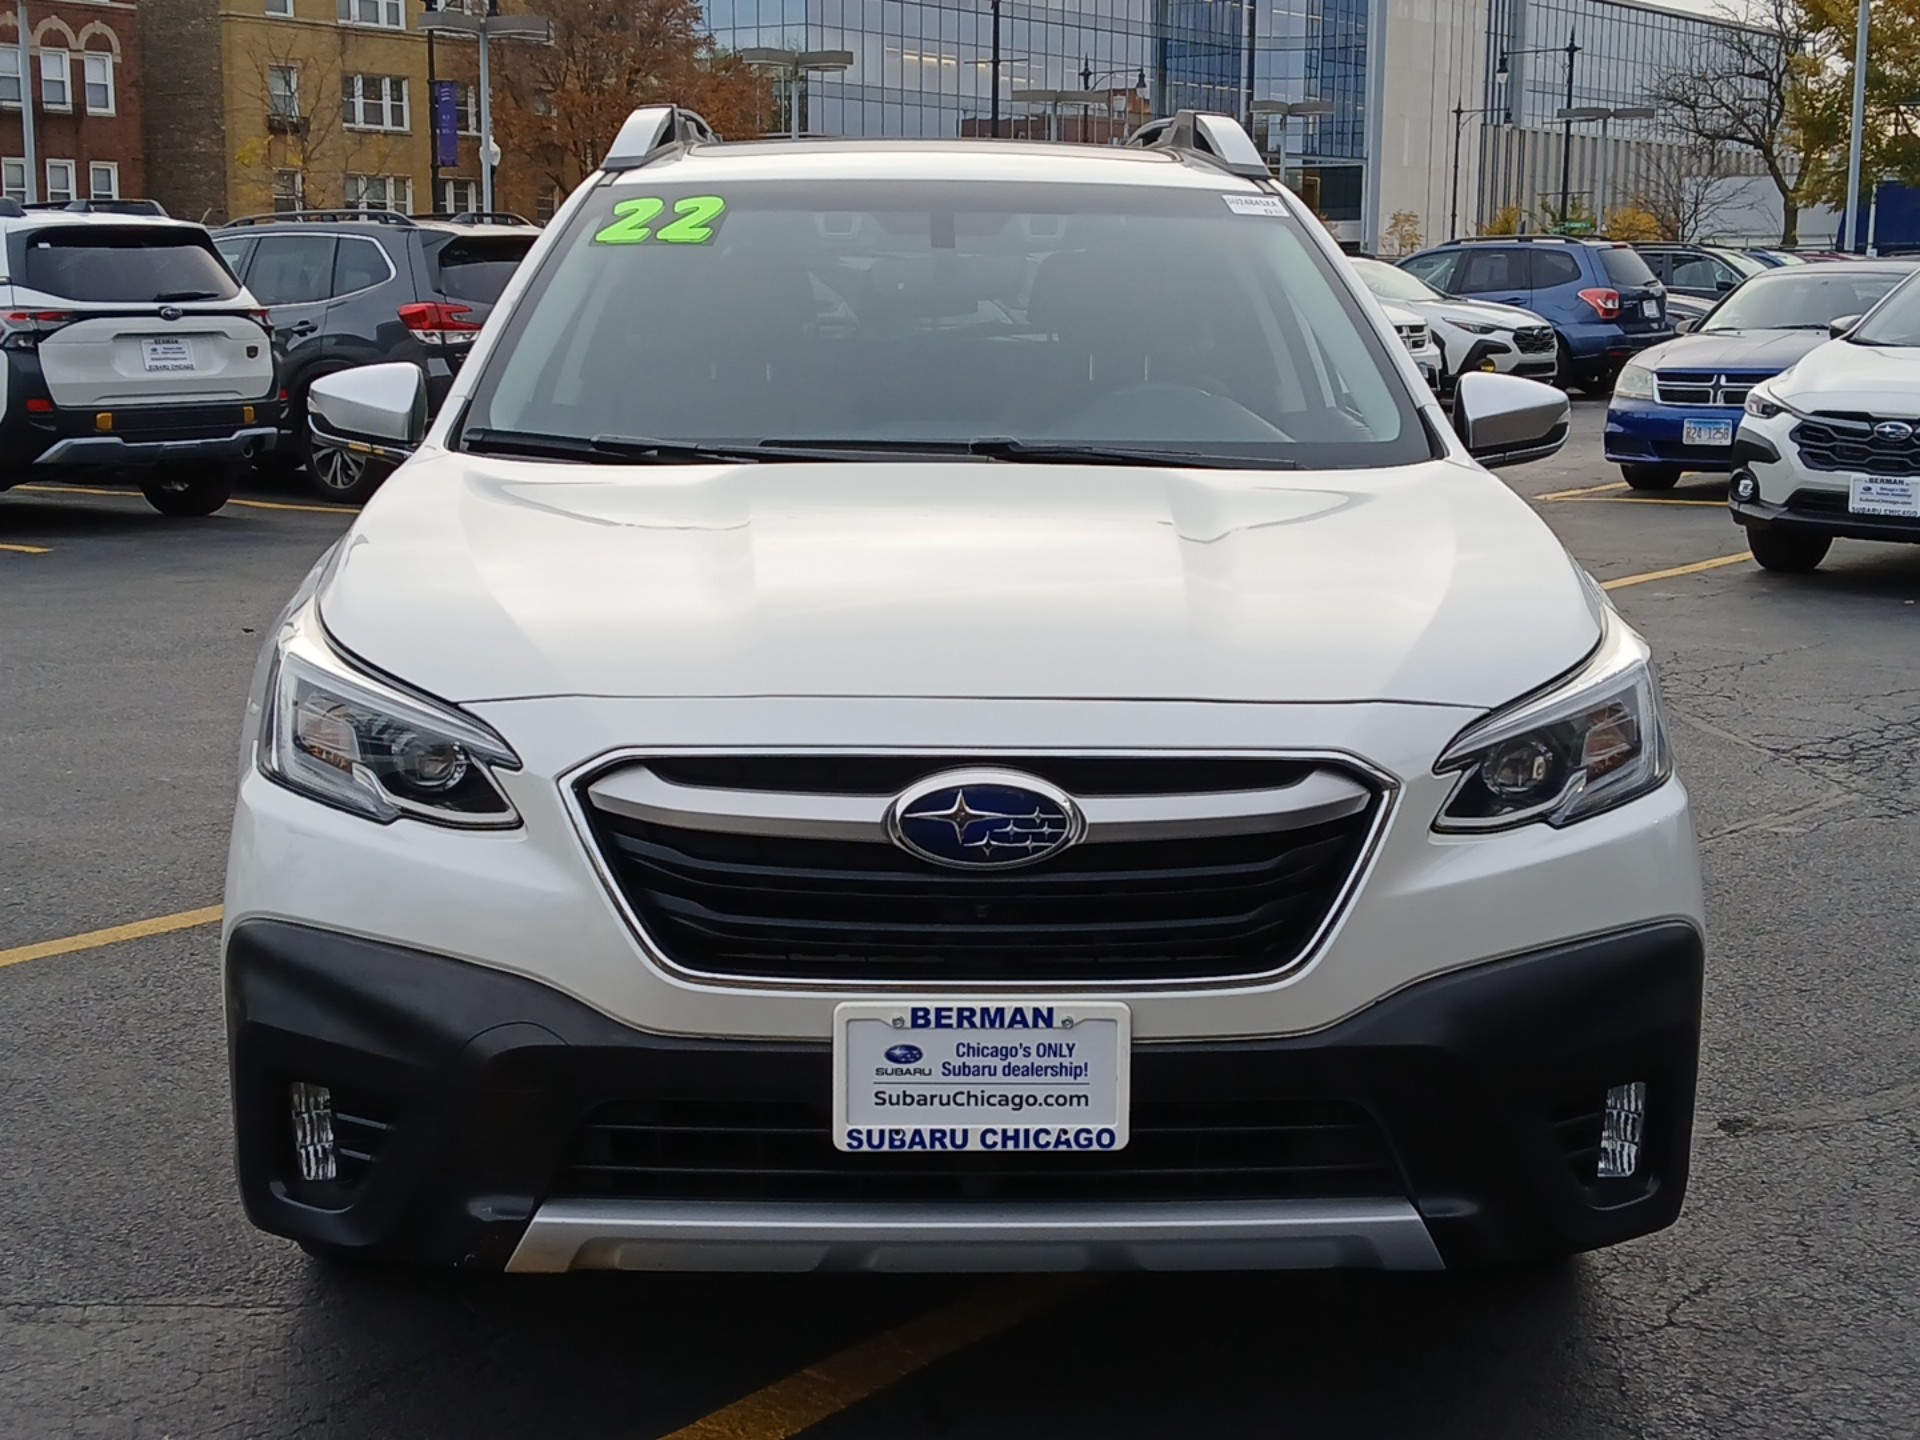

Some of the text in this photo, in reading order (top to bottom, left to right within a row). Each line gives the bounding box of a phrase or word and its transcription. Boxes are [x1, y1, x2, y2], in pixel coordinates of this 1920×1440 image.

[594, 194, 726, 246] 22
[1869, 477, 1904, 485] BERMAN
[910, 1006, 1054, 1029] BERMAN
[955, 1042, 1076, 1061] Chicago's ONLY
[875, 1067, 932, 1077] SUBARU
[941, 1061, 1089, 1080] Subaru dealership!
[874, 1089, 1089, 1111] SubaruChicago.com
[846, 1128, 1116, 1150] SUBARU CHICAGO
